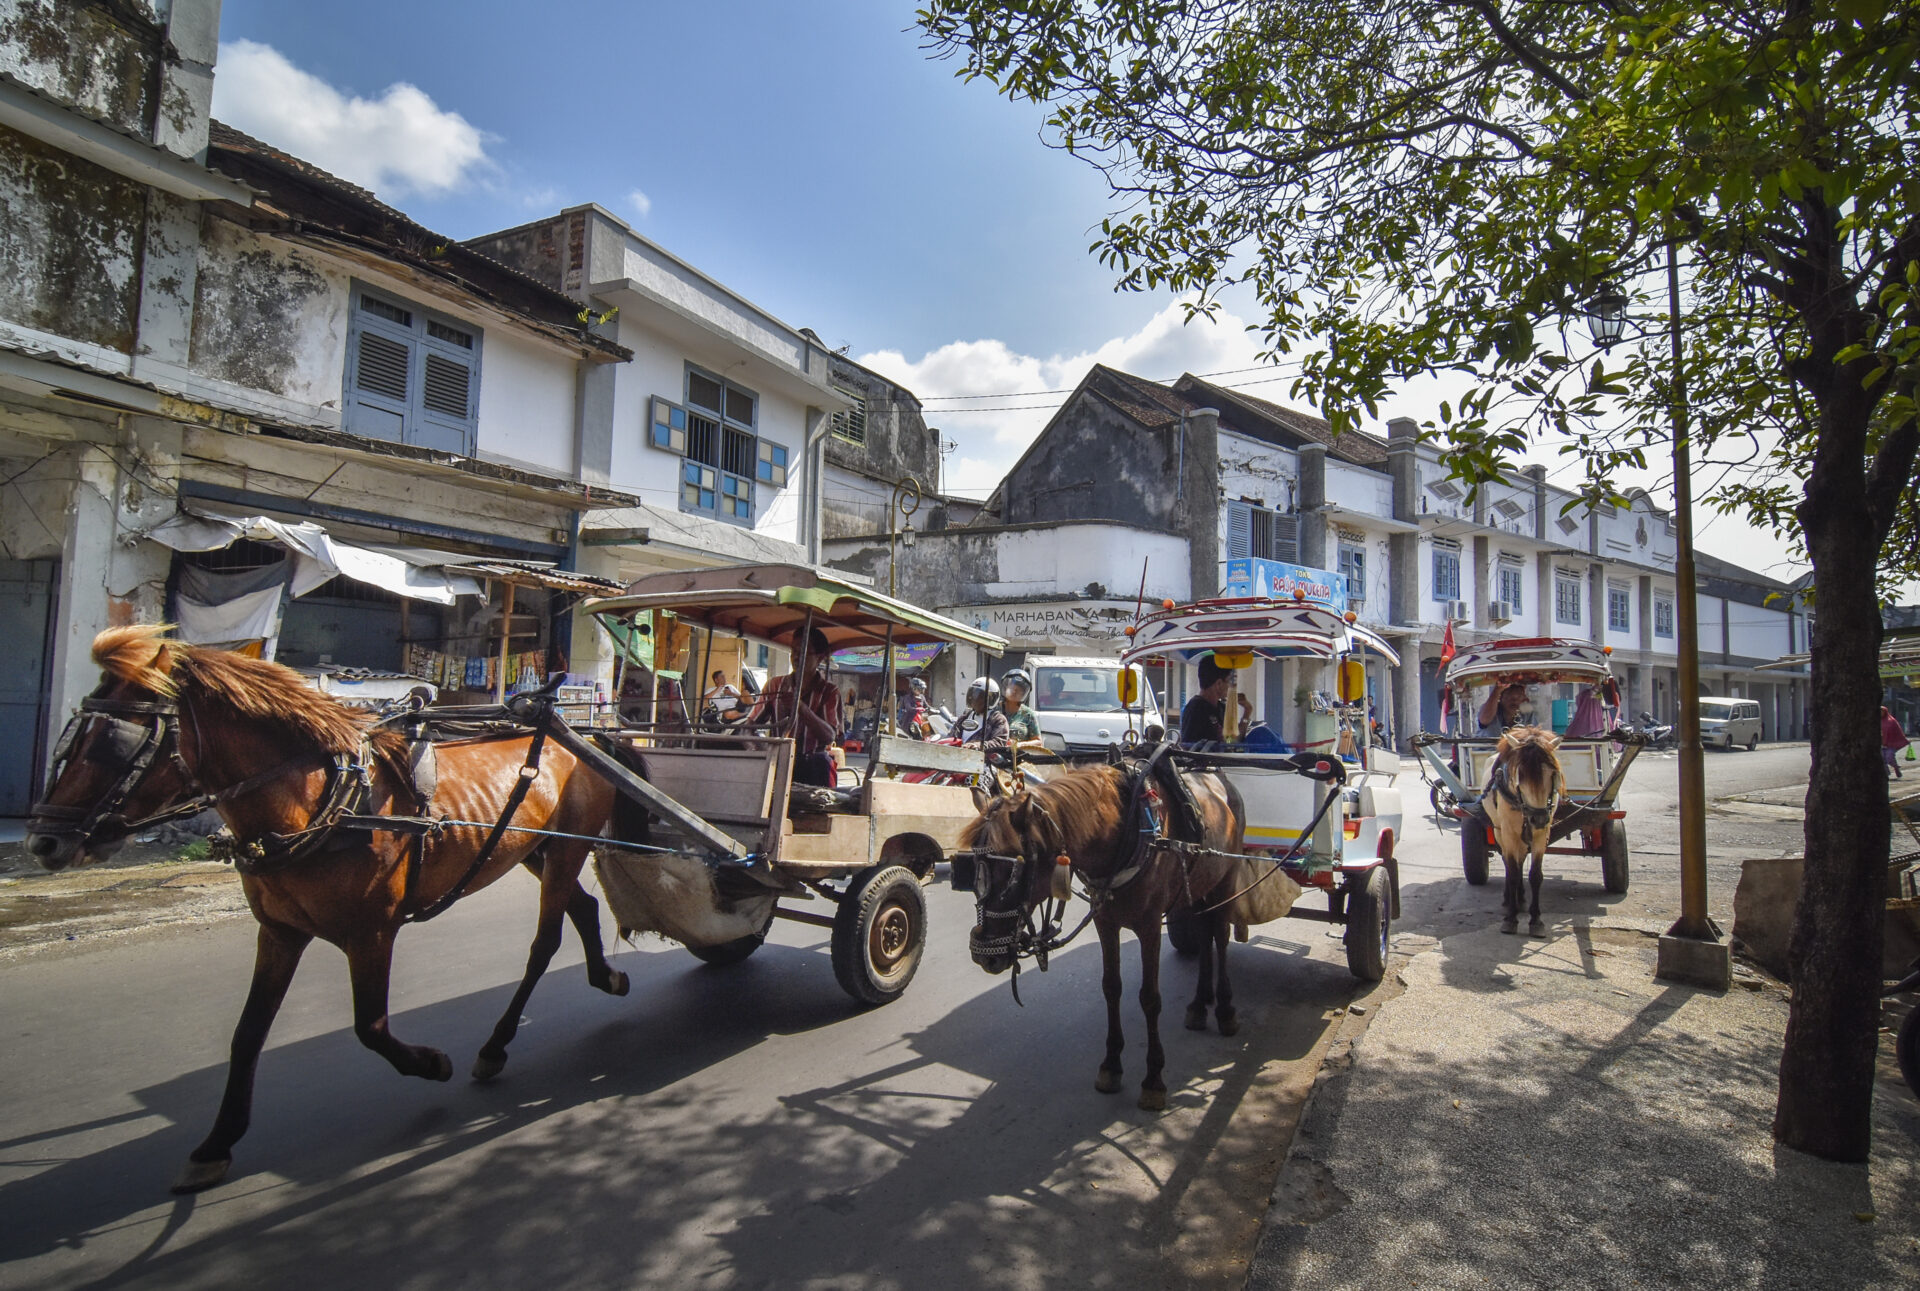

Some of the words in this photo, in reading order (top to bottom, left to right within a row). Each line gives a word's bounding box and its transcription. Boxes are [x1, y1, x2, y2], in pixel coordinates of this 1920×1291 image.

[994, 611, 1074, 623] MARHABAN
[1080, 607, 1099, 620] YA
[1014, 625, 1048, 637] Selamat
